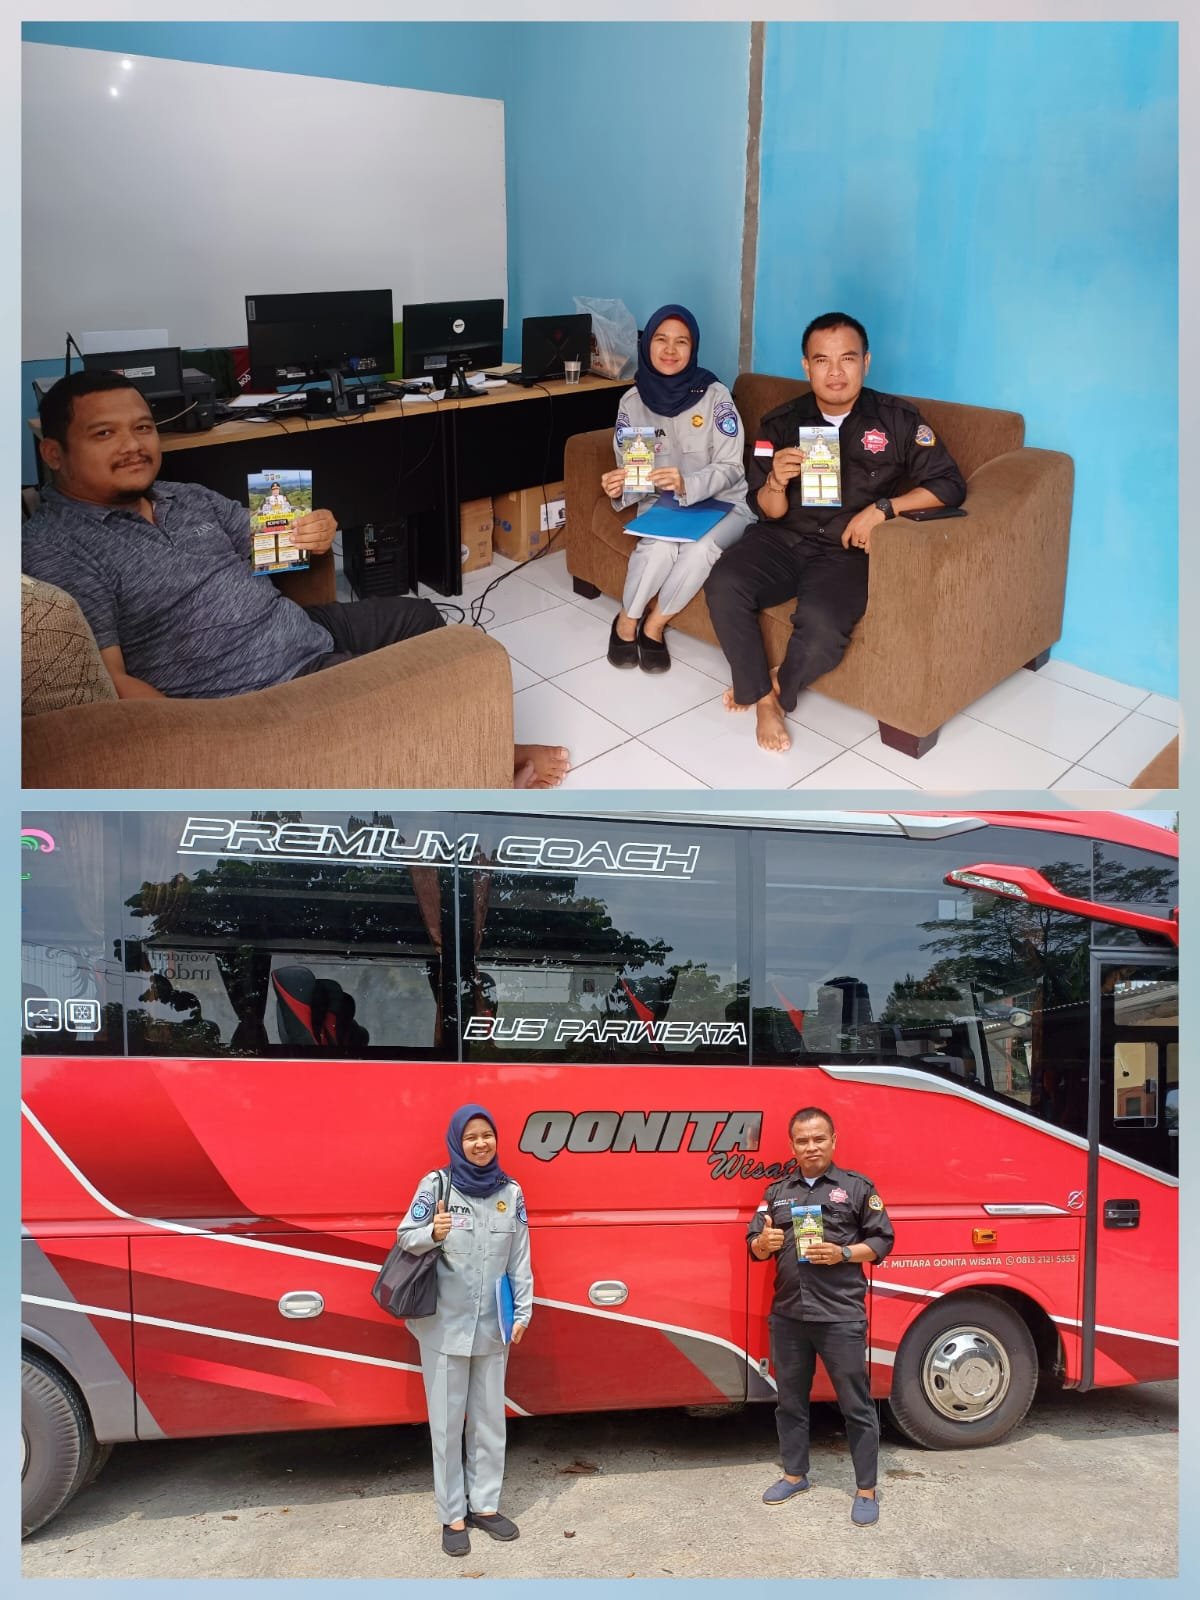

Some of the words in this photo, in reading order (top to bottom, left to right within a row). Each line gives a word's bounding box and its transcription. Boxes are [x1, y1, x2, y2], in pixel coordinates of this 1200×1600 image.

[179, 816, 479, 862] PREMIUM
[497, 835, 701, 874] COACH
[463, 1016, 548, 1042] BUS
[554, 1019, 747, 1046] PARIWISATA
[518, 1110, 763, 1162] QONITA
[707, 1151, 799, 1180] Wisat
[891, 1258, 931, 1269] MUTIARA
[933, 1257, 967, 1268] QONITA
[969, 1256, 1002, 1266] WISATA
